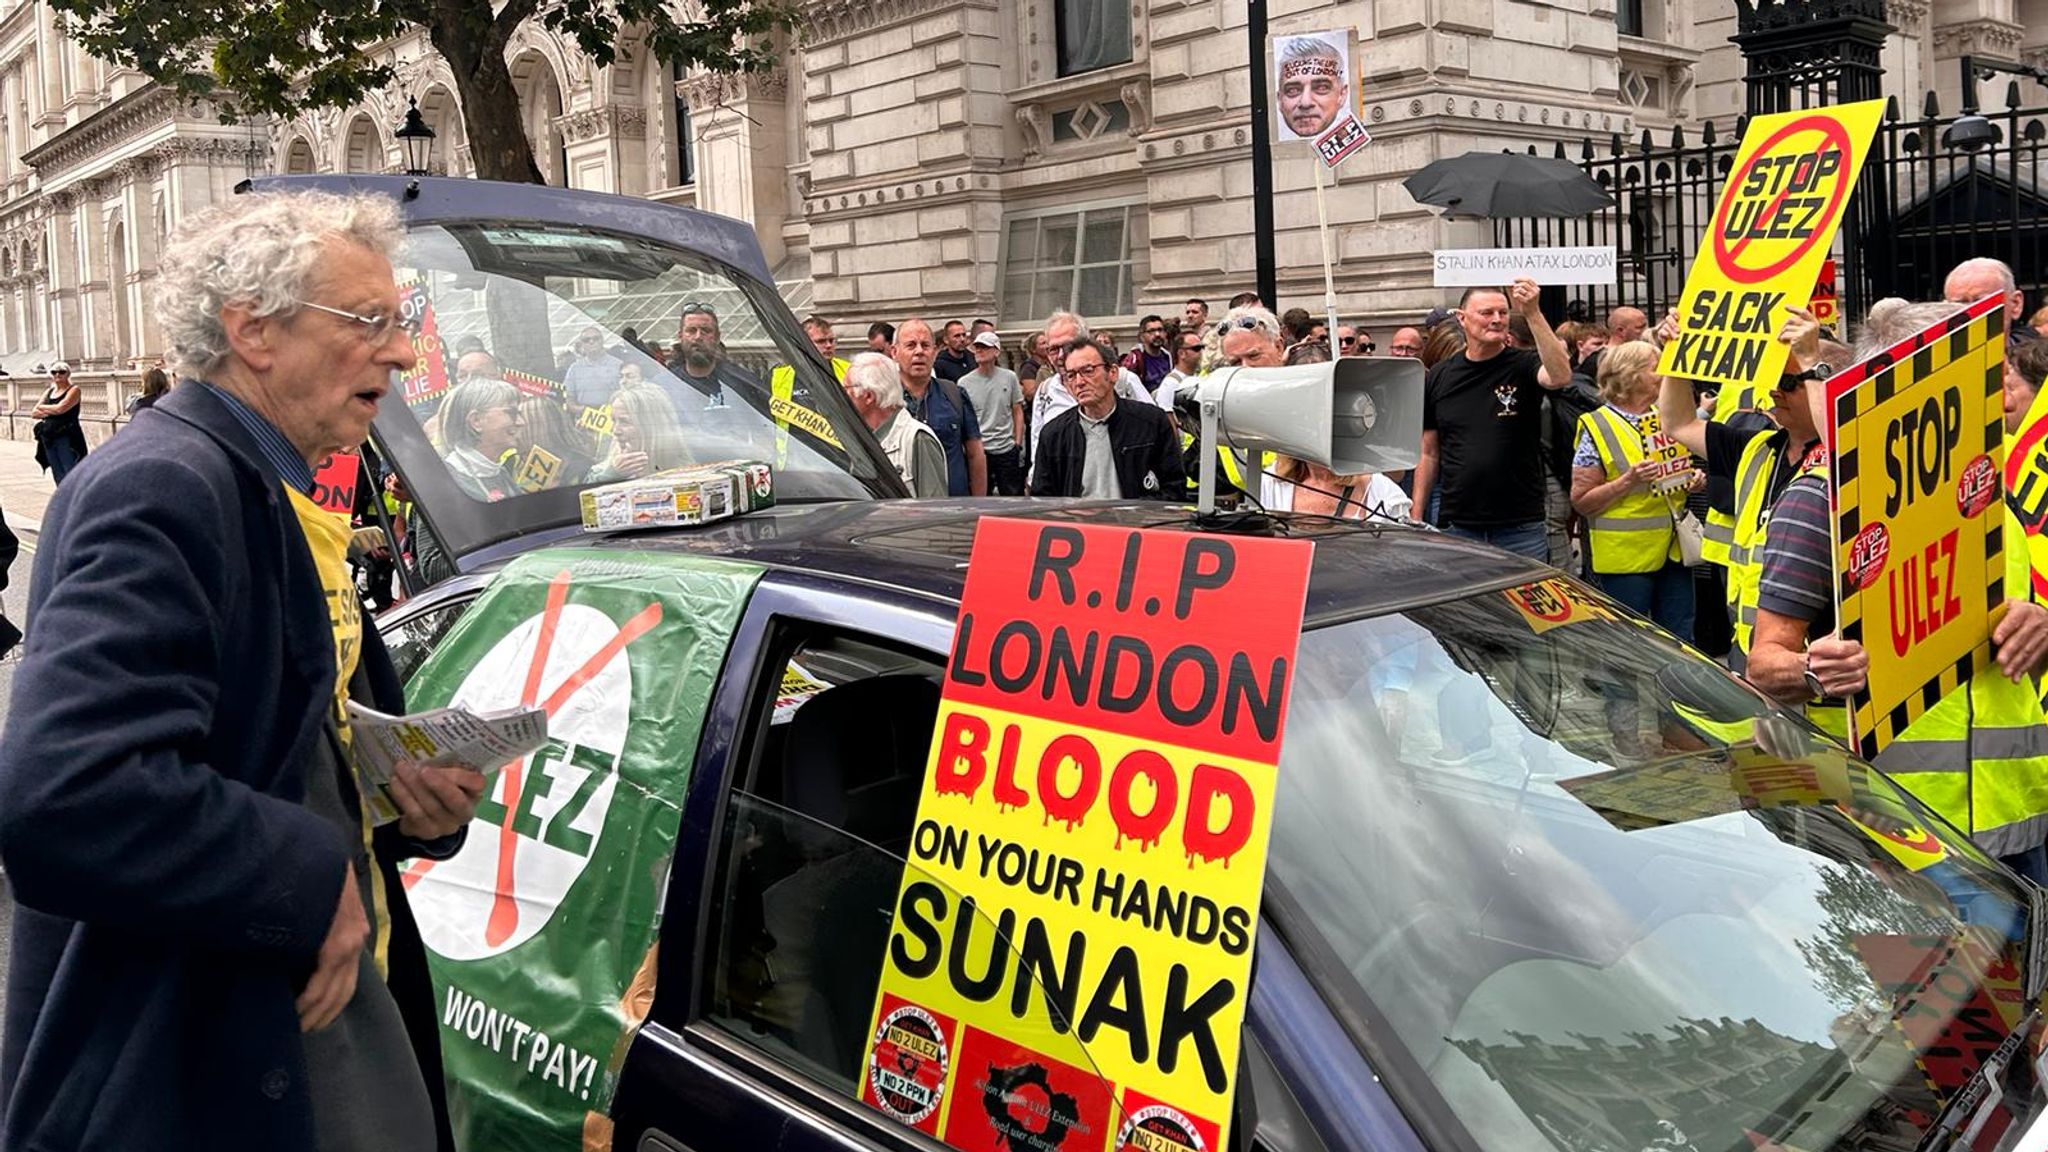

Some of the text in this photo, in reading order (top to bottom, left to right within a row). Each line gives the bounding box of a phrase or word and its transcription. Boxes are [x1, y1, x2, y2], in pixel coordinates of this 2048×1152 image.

[1743, 148, 1842, 197] STOP
[1724, 197, 1825, 240] ULEZ
[1437, 255, 1483, 270] STALIN
[1562, 252, 1612, 269] LONDON
[1688, 290, 1785, 334] SACK
[1672, 333, 1767, 382] KHAN
[404, 376, 431, 398] LIE
[585, 411, 608, 429] NO
[771, 399, 828, 434] GET KHAN
[1659, 446, 1677, 461] TO
[1885, 385, 1961, 519] STOP
[1958, 468, 1995, 503] ULEZ
[1963, 459, 1990, 484] STOP
[1850, 535, 1888, 573] ULEZ
[1855, 527, 1882, 553] STOP
[1028, 526, 1236, 620] R.I.P
[1890, 528, 1960, 658] ULEZ
[950, 613, 1287, 742] LONDON
[476, 735, 620, 858] LEZ
[934, 711, 1256, 867] BLOOD
[914, 819, 1252, 957] ON YOUR HANDS
[890, 881, 1236, 1095] SUNAK
[443, 985, 598, 1100] WON'T PAY!
[889, 1027, 937, 1058] NO 2 ULEZ
[883, 1073, 897, 1090] NO
[898, 1079, 905, 1093] 2
[889, 1093, 915, 1115] OUT
[1145, 1107, 1169, 1118] STOP
[989, 1115, 1010, 1134] Road
[1010, 1128, 1027, 1141] user
[1134, 1130, 1152, 1149] NO
